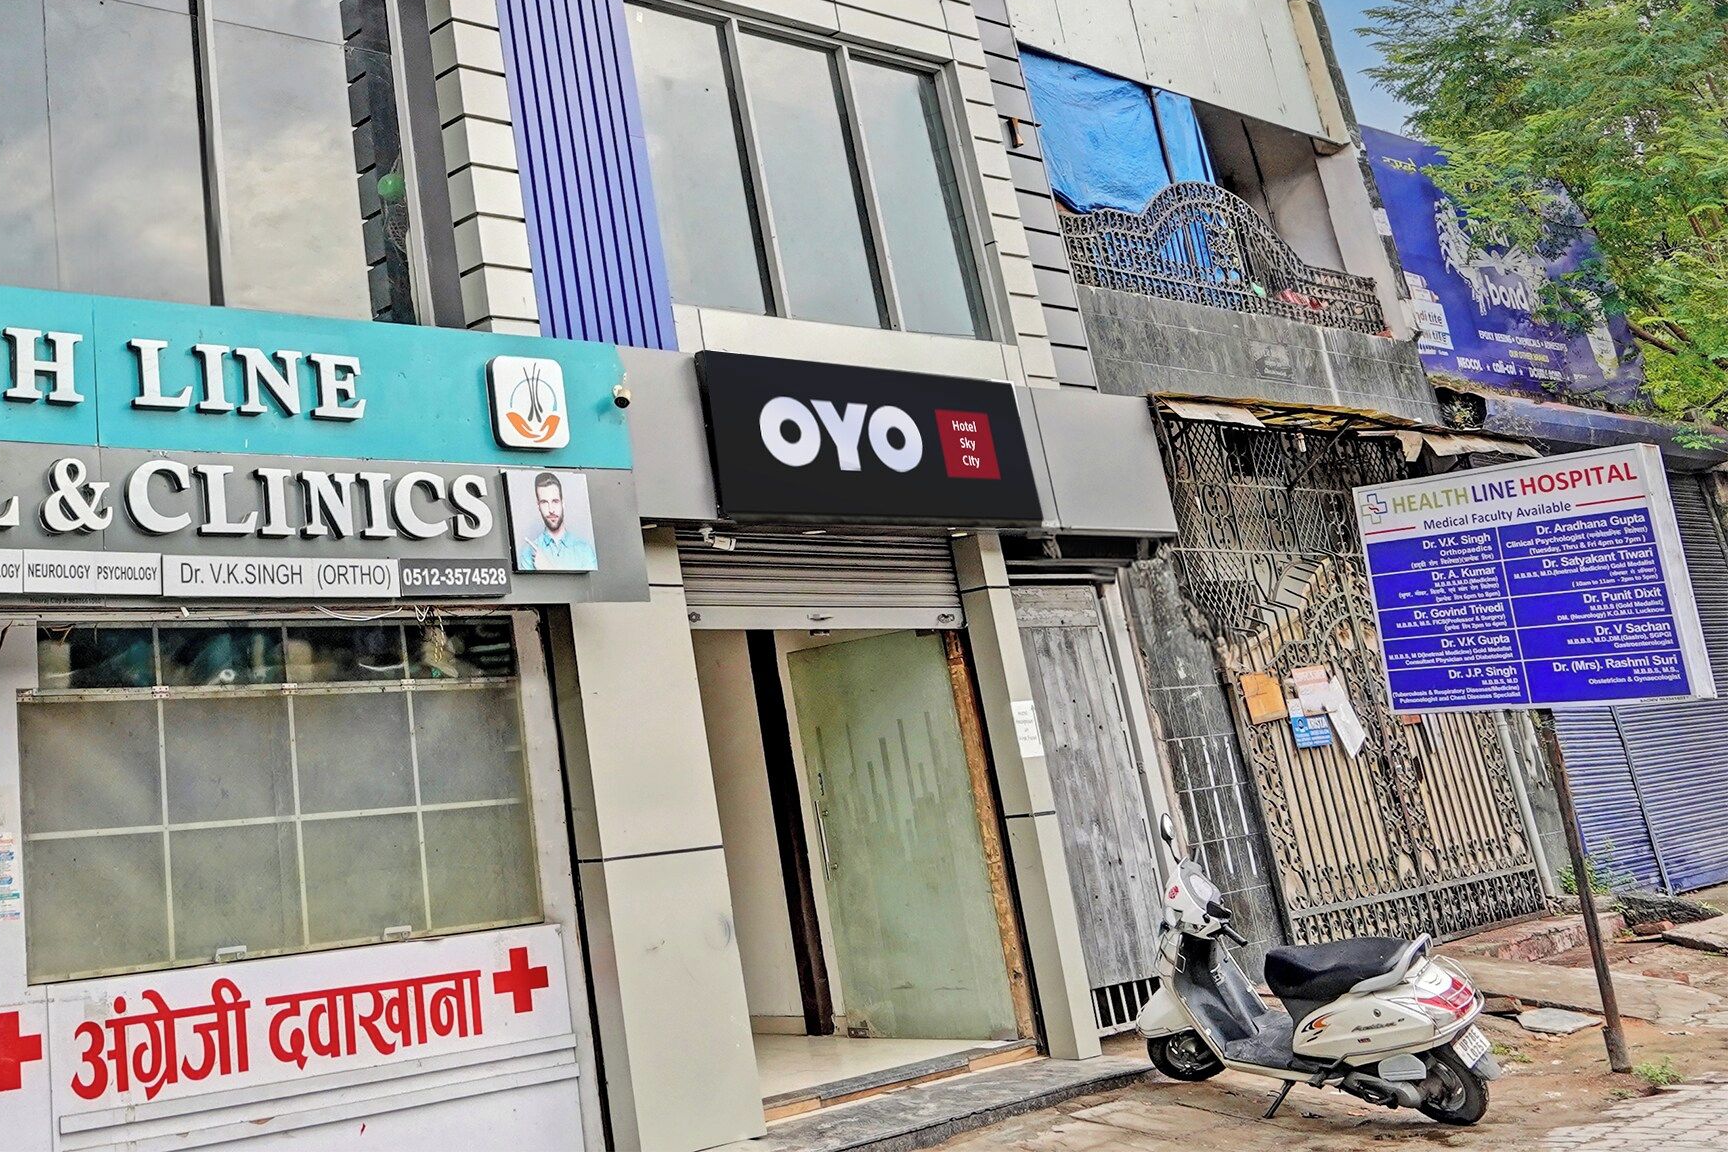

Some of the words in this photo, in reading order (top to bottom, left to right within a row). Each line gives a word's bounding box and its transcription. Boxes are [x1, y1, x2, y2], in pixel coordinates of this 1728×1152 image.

[127, 338, 367, 421] LINE
[759, 396, 923, 473] OYO
[951, 419, 978, 433] Hotel
[959, 436, 976, 452] Sky
[962, 454, 980, 469] City
[1392, 486, 1469, 514] HEALTH
[1471, 479, 1517, 503] LINE
[1519, 462, 1638, 496] HOSPITAL
[125, 459, 493, 541] CLINICS
[1423, 514, 1469, 531] Medical
[1471, 508, 1513, 523] Faculty
[1516, 500, 1572, 518] Available
[1535, 525, 1552, 536] Dr.
[1554, 518, 1608, 533] Aradhana
[1610, 513, 1646, 529] Gupta
[1423, 540, 1437, 550] Dr.
[1438, 537, 1459, 548] V.K.
[1460, 532, 1492, 545] Singh
[1505, 539, 1534, 549] Clinical
[1534, 533, 1586, 545] Psychologist
[1439, 545, 1493, 557] Orthopaedics
[1542, 558, 1558, 569] Dr.
[1560, 552, 1616, 568] Satyakant
[1617, 547, 1654, 560] Tiwari
[27, 562, 90, 580] NEUROLOGY
[96, 566, 158, 582] PSYCHOLOGY
[180, 562, 204, 584] Dr.
[210, 562, 303, 585] V.K.SINGH
[317, 564, 392, 588] (ORTHO)
[402, 566, 507, 587] 0512-3574528
[1431, 571, 1447, 581] Dr.
[1448, 569, 1459, 579] A.
[1461, 566, 1497, 578] Kumar
[1583, 593, 1599, 604] Dr.
[1601, 589, 1632, 603] Punit
[1634, 586, 1662, 599] Dixit
[1413, 609, 1429, 620] Dr.
[1430, 605, 1468, 619] Govind
[1469, 602, 1505, 616] Trivedi
[1595, 625, 1612, 636] Dr.
[1613, 623, 1623, 635] V
[1625, 621, 1671, 634] Sachan
[1440, 638, 1456, 649] Dr.
[1477, 633, 1511, 647] Gupta
[1447, 669, 1464, 680] Dr.
[1465, 667, 1484, 679] J.P.
[1485, 665, 1518, 679] Singh
[1553, 661, 1569, 673] Dr.
[1571, 659, 1604, 674] (Mrs).
[1605, 655, 1650, 669] Rashmi
[1651, 654, 1679, 666] Suri
[71, 977, 251, 1100] अंग्रेजी
[265, 969, 483, 1070] दवाखाना
